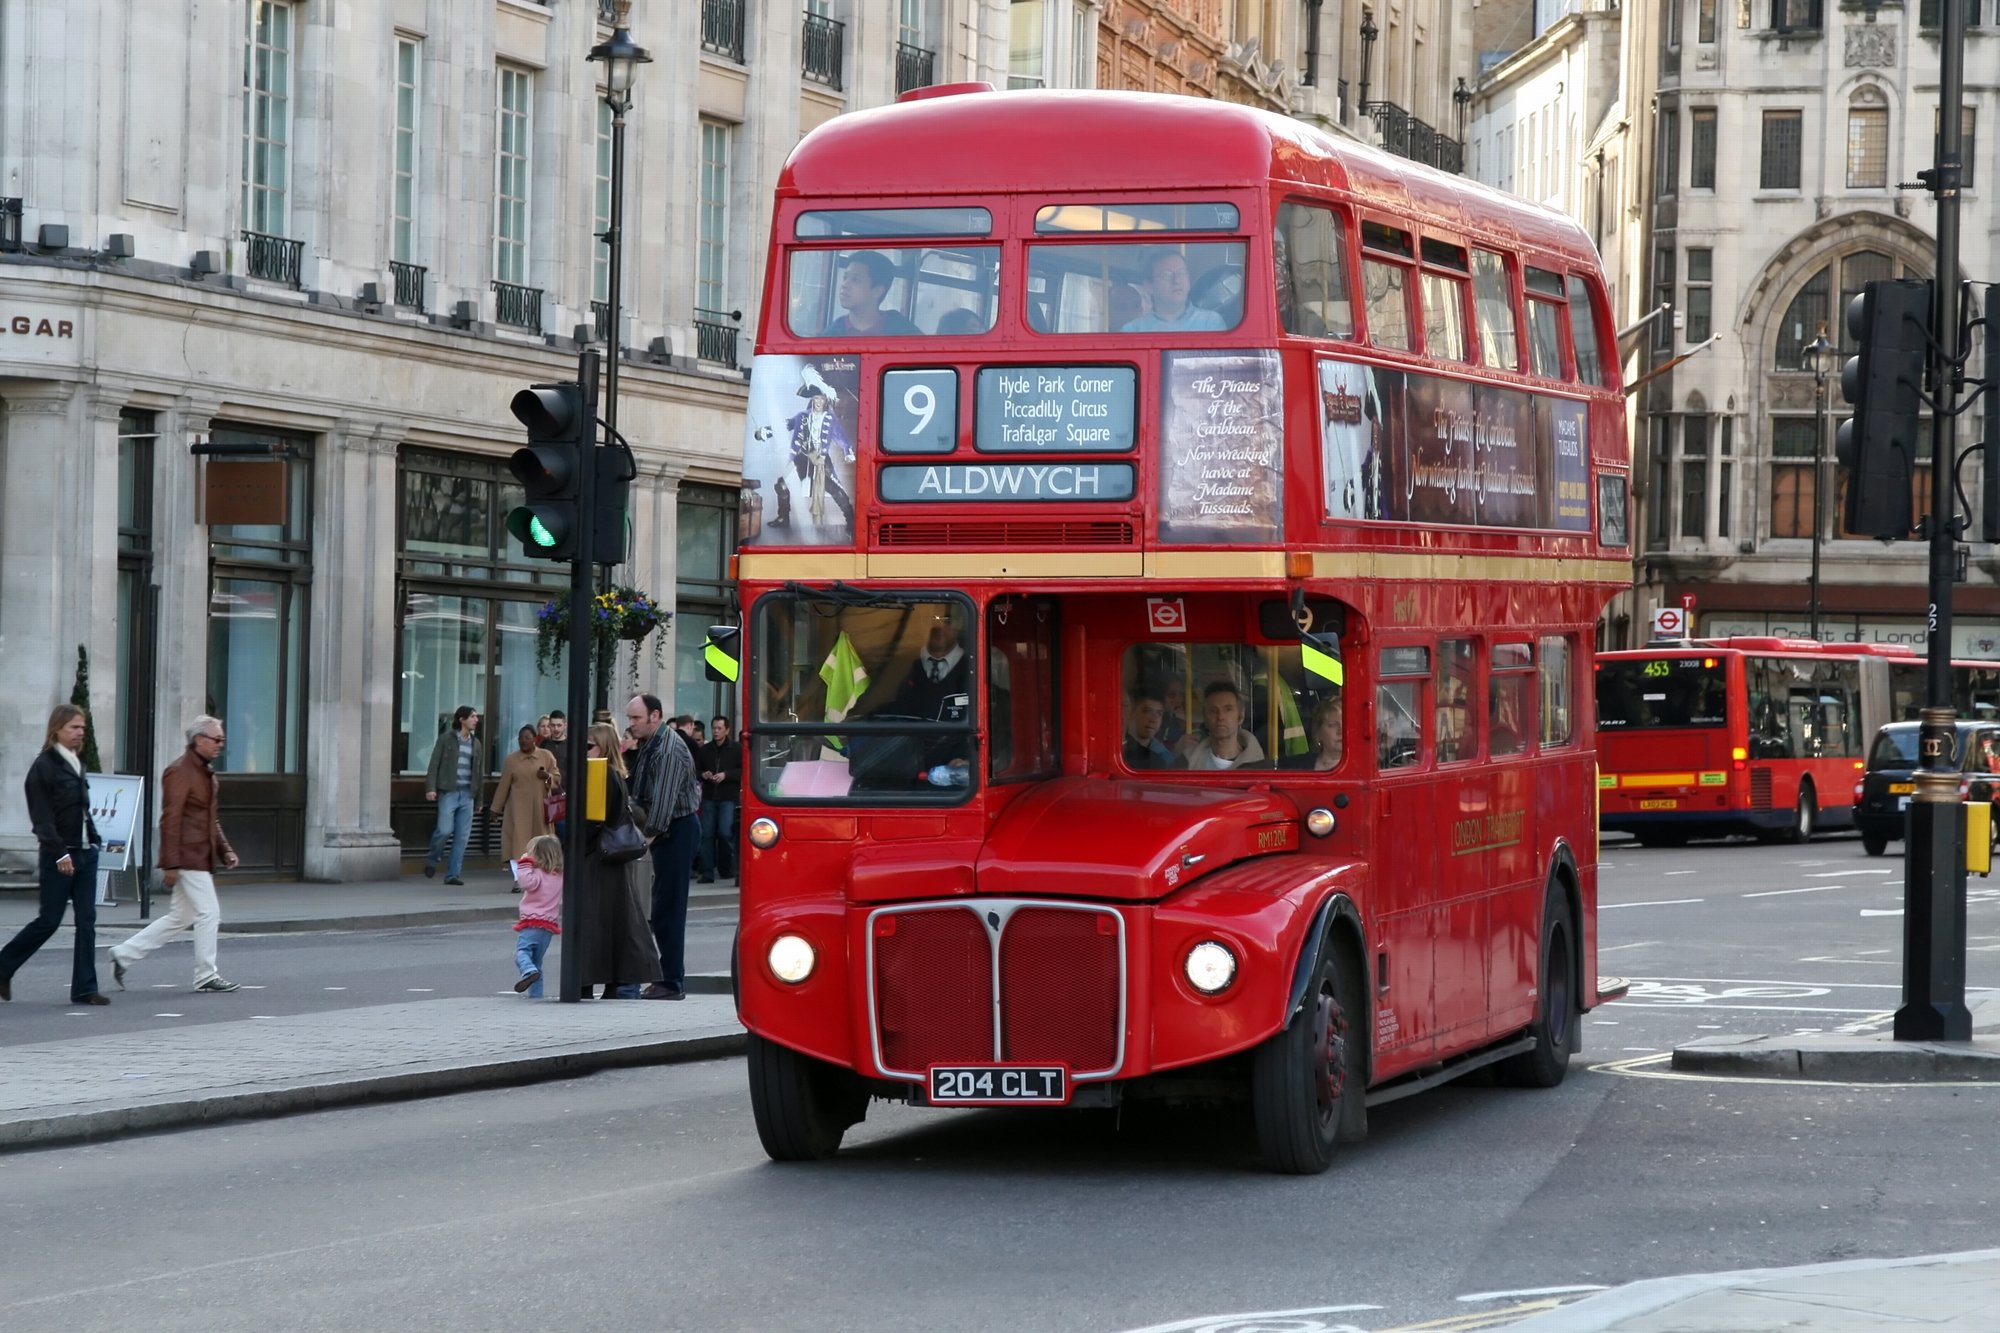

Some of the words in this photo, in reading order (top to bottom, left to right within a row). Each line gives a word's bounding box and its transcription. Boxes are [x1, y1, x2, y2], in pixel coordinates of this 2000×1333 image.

[999, 377, 1030, 398] Hyde
[1038, 376, 1065, 393] Park
[1073, 375, 1114, 393] Corner
[1192, 376, 1216, 394] The
[1212, 380, 1260, 398] Pirates
[903, 384, 936, 435] 9
[1004, 400, 1063, 422] Piccadilly
[1071, 399, 1108, 417] Circus
[1208, 400, 1222, 417] of
[1223, 400, 1241, 414] the
[1001, 424, 1057, 445] Trafalgar
[1066, 424, 1111, 445] Square
[1197, 417, 1257, 437] Caribbean.
[1178, 448, 1214, 465] Now
[1218, 449, 1269, 465] wreaking
[917, 466, 1099, 495] ALDWYCH
[1201, 466, 1236, 479] havoc
[1238, 468, 1251, 478] at
[1193, 483, 1254, 500] Madame
[1200, 501, 1254, 514] Tussauds.
[1683, 596, 1693, 608] T
[1291, 606, 1314, 633] 9
[1772, 626, 1835, 642] Crest
[1844, 629, 1867, 643] of
[1875, 629, 1929, 644] Lond
[1643, 660, 1670, 677] 453
[1679, 659, 1700, 668] 23008
[1258, 829, 1287, 849] RM1204
[1450, 818, 1483, 857] LONDON
[938, 1071, 994, 1097] 204
[1001, 1071, 1057, 1097] CLT
